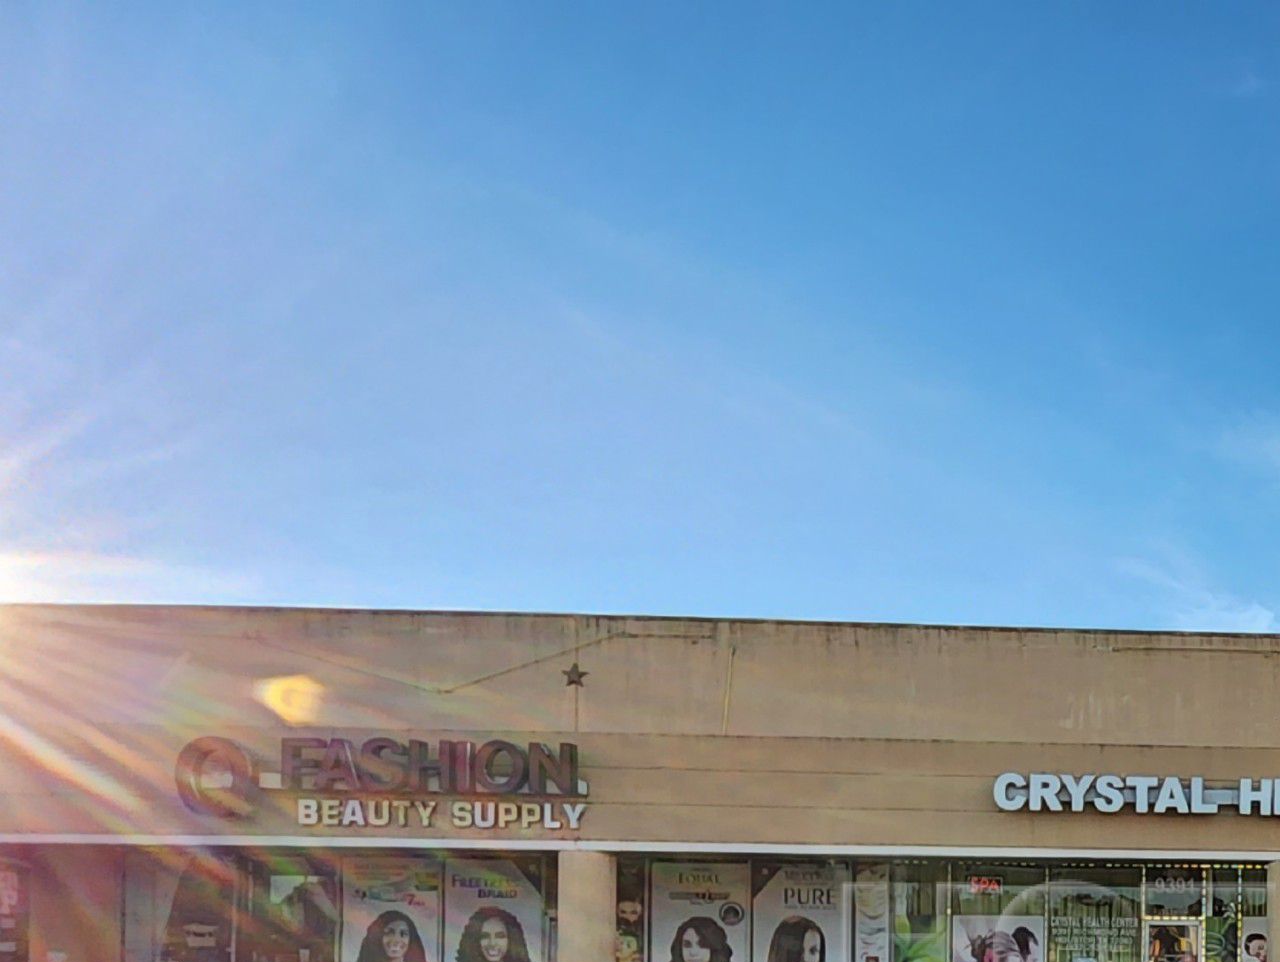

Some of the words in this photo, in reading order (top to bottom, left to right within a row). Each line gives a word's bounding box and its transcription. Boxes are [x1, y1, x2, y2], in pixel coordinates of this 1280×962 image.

[281, 738, 579, 795] FASHION
[298, 799, 436, 827] BEAUTY
[452, 802, 587, 830] SUPPLY
[784, 888, 836, 905] PURE
